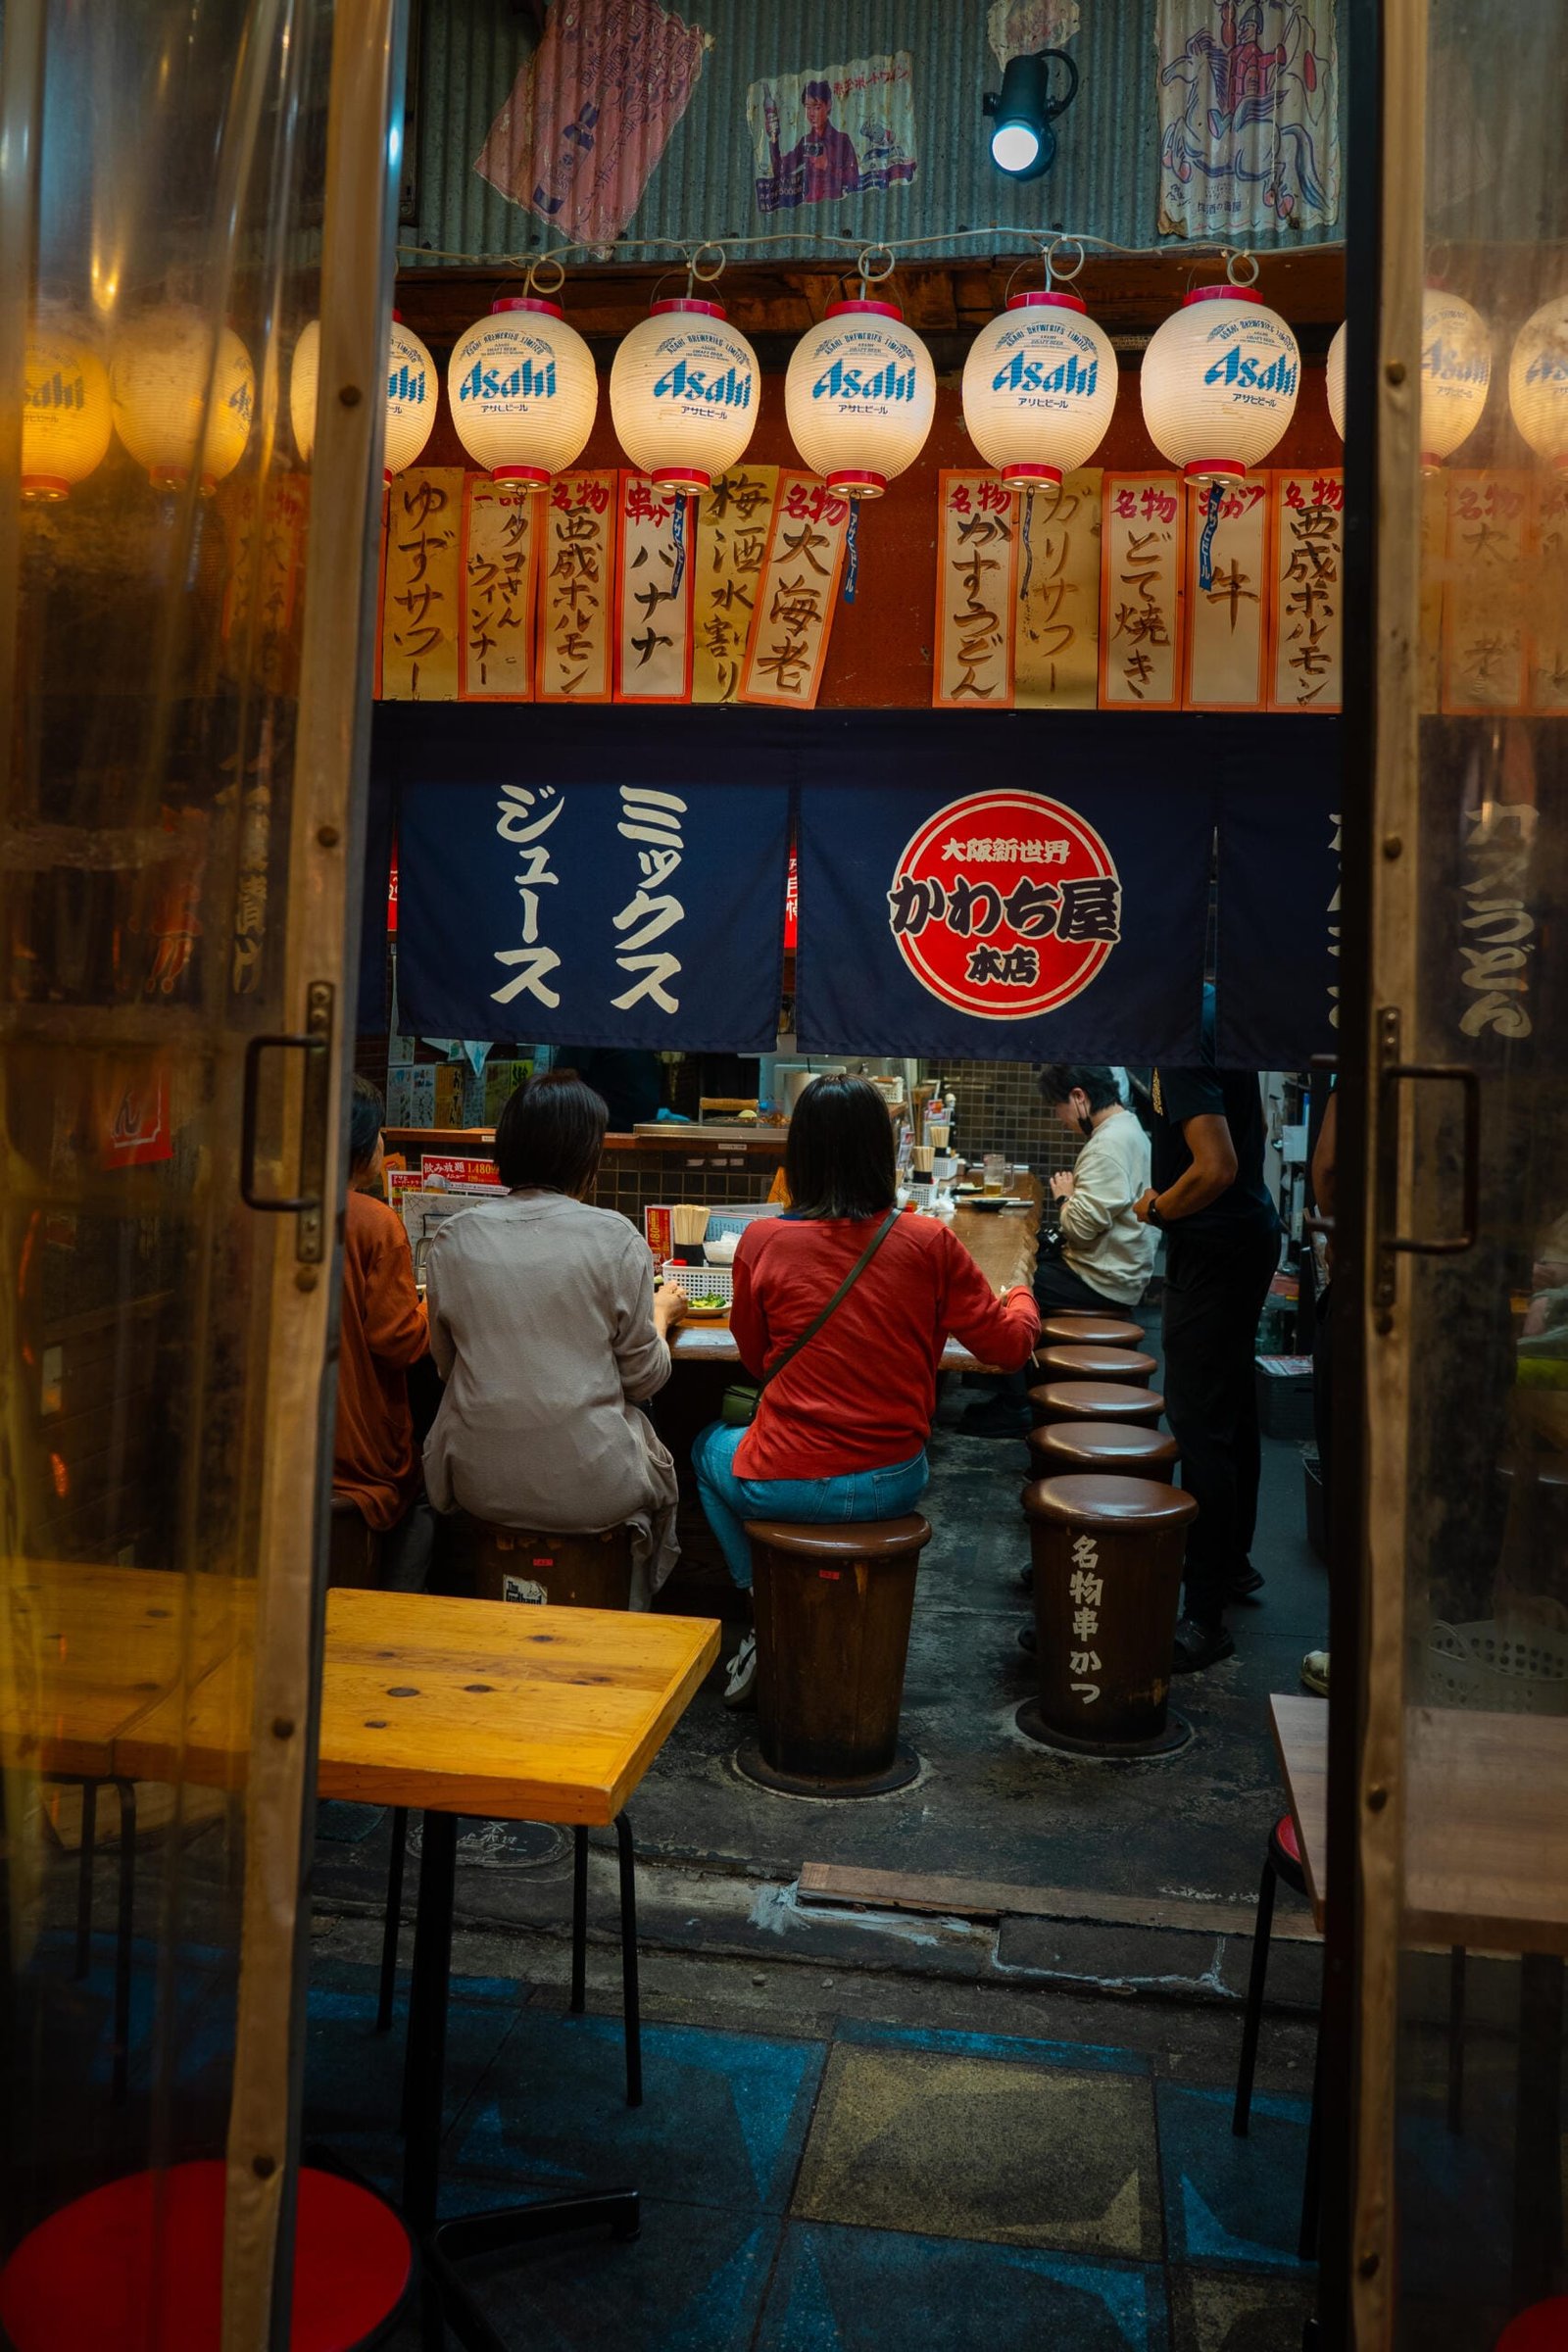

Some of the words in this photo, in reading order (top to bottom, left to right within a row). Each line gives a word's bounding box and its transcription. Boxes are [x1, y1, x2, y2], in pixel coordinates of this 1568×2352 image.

[459, 358, 557, 402] Asahi
[653, 359, 752, 410] Asahi
[811, 358, 916, 403] Asahi
[992, 349, 1099, 397] Asahi
[1203, 344, 1298, 397] Asahi
[681, 406, 727, 419] アサヒビール
[838, 404, 888, 416] アサヒビール
[1232, 393, 1276, 408] アサヒビール
[549, 479, 610, 514] 名物
[777, 483, 849, 526] 名物
[948, 480, 1012, 514] 名物
[1109, 486, 1177, 523] 名物
[1281, 478, 1344, 512] 名物
[549, 506, 603, 694] 西成ホルモン
[630, 545, 676, 671] バナナ
[704, 473, 772, 702] 梅酒水割り
[758, 523, 832, 695] 大海老
[951, 513, 1013, 701] かすうどん
[1206, 558, 1260, 636] 牛
[1282, 505, 1342, 706] 西成ホルモン
[1111, 530, 1171, 699] どて焼き
[941, 838, 1071, 864] 大阪新世界
[490, 784, 565, 1009] ジュース
[610, 784, 688, 1014] ミックス
[887, 874, 1122, 945] かわち屋
[964, 943, 1040, 986] 本店
[423, 1161, 466, 1174] 飲み放題
[1068, 1534, 1104, 1705] 名物串かつ
